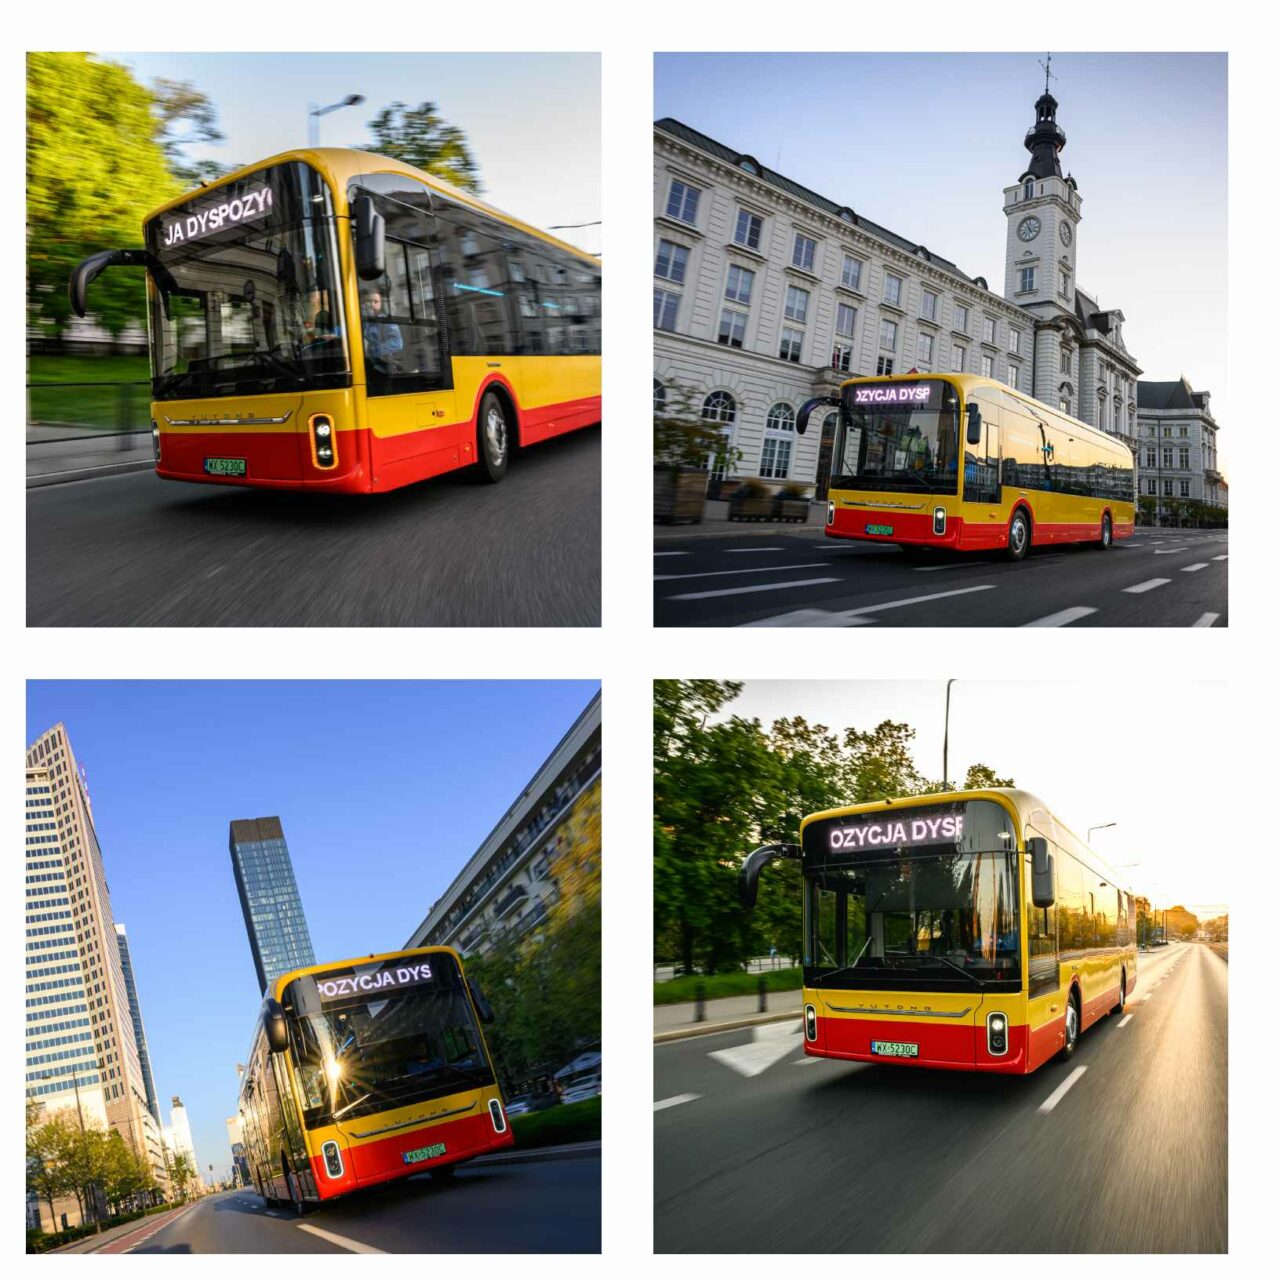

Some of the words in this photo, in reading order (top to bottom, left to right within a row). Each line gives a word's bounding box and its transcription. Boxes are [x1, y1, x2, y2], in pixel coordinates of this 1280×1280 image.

[164, 221, 184, 245] JA
[208, 460, 218, 471] WX
[219, 460, 244, 472] 5230C
[396, 964, 432, 983] DYS
[876, 1043, 888, 1052] WX
[889, 1043, 916, 1054] 5230C
